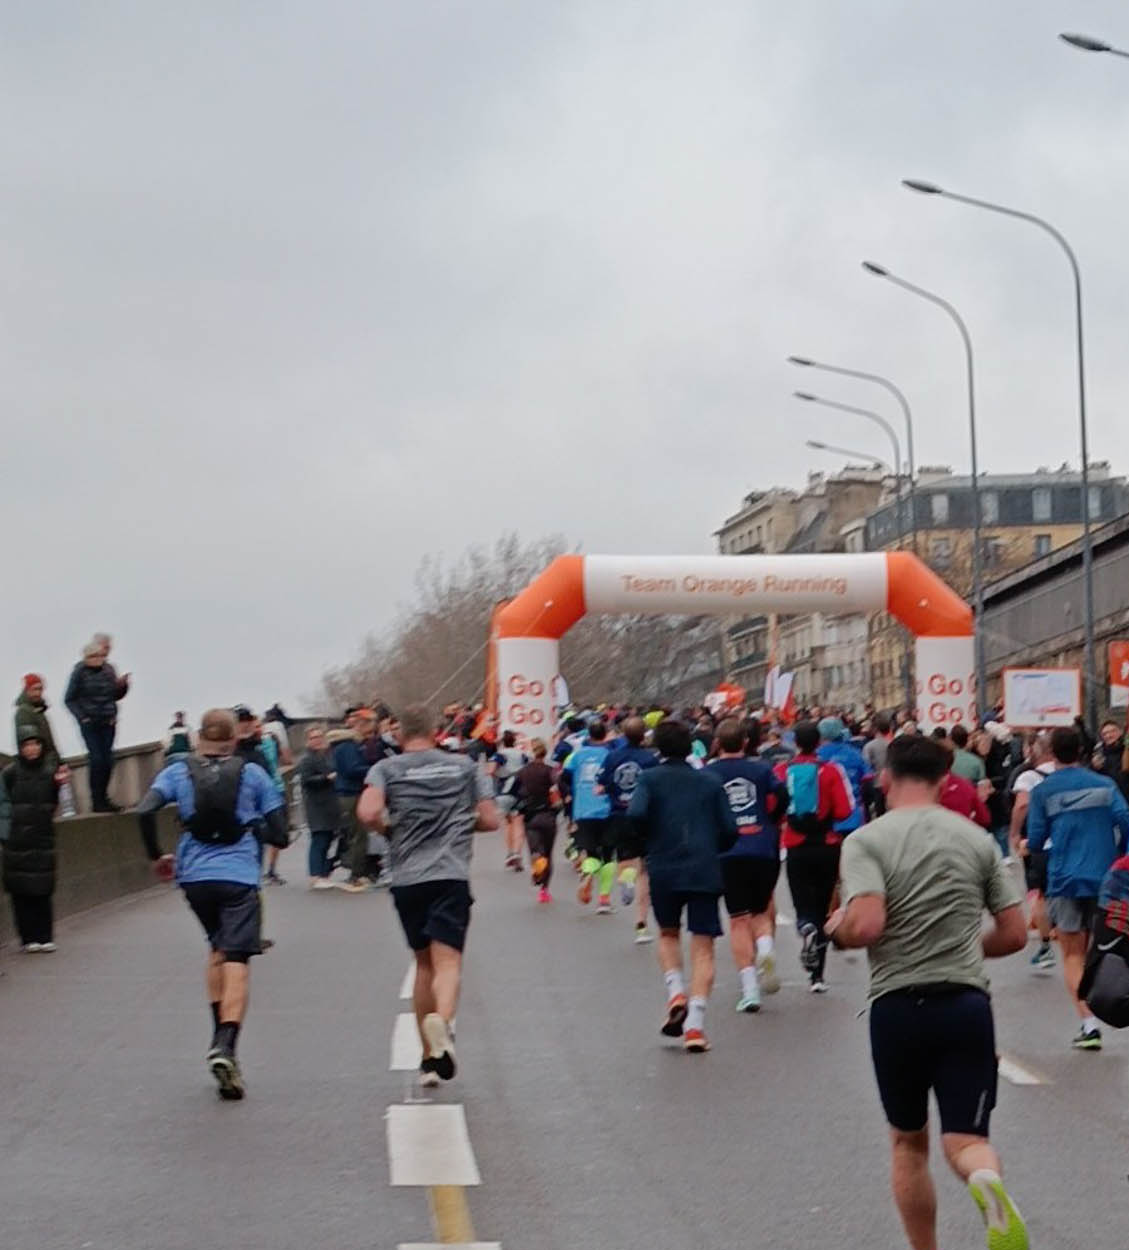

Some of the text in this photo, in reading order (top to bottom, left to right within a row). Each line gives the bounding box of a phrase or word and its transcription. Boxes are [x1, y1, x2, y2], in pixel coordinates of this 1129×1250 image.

[622, 575, 847, 597] Team Orange Running
[508, 674, 544, 696] Go
[929, 673, 963, 696] Go
[508, 703, 544, 724] Go
[929, 702, 963, 723] Go
